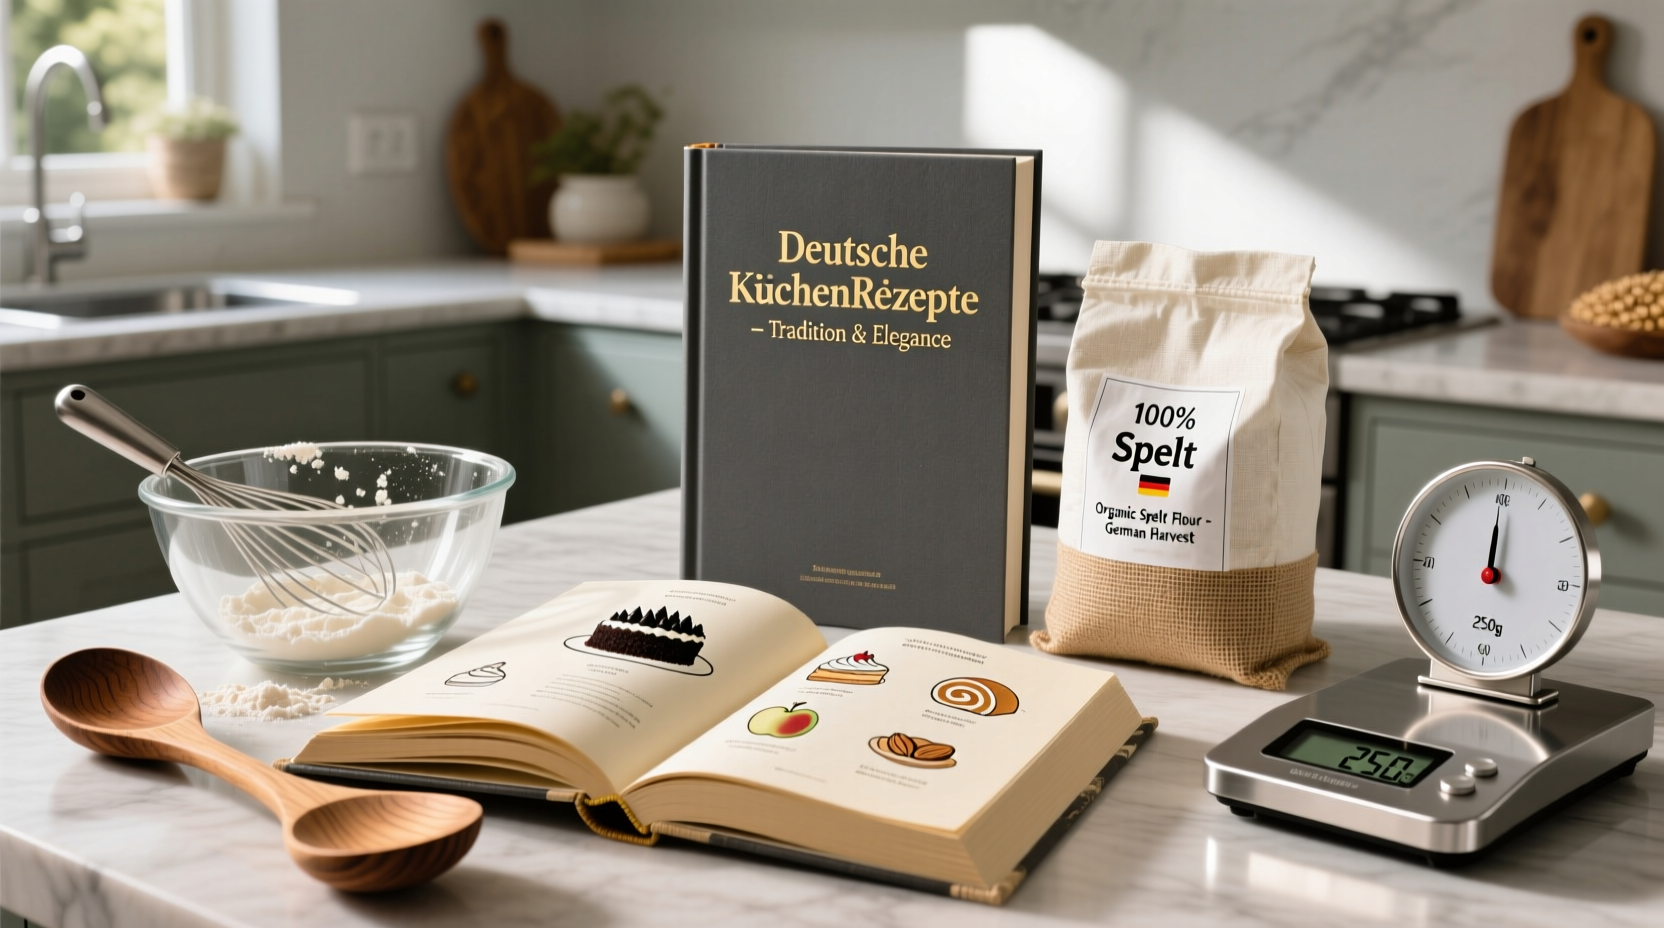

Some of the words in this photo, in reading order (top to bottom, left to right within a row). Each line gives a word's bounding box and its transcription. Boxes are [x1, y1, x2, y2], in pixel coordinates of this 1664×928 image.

[778, 230, 928, 269] Deutsche
[769, 320, 846, 342] Tradition
[852, 324, 867, 344] &
[872, 325, 951, 352] Elegance
[1135, 402, 1196, 430] 100%
[1111, 431, 1198, 472] Spelt
[1095, 501, 1136, 520] Organic
[1172, 511, 1203, 526] Flour
[1105, 522, 1146, 539] German
[1150, 527, 1196, 544] Harvest
